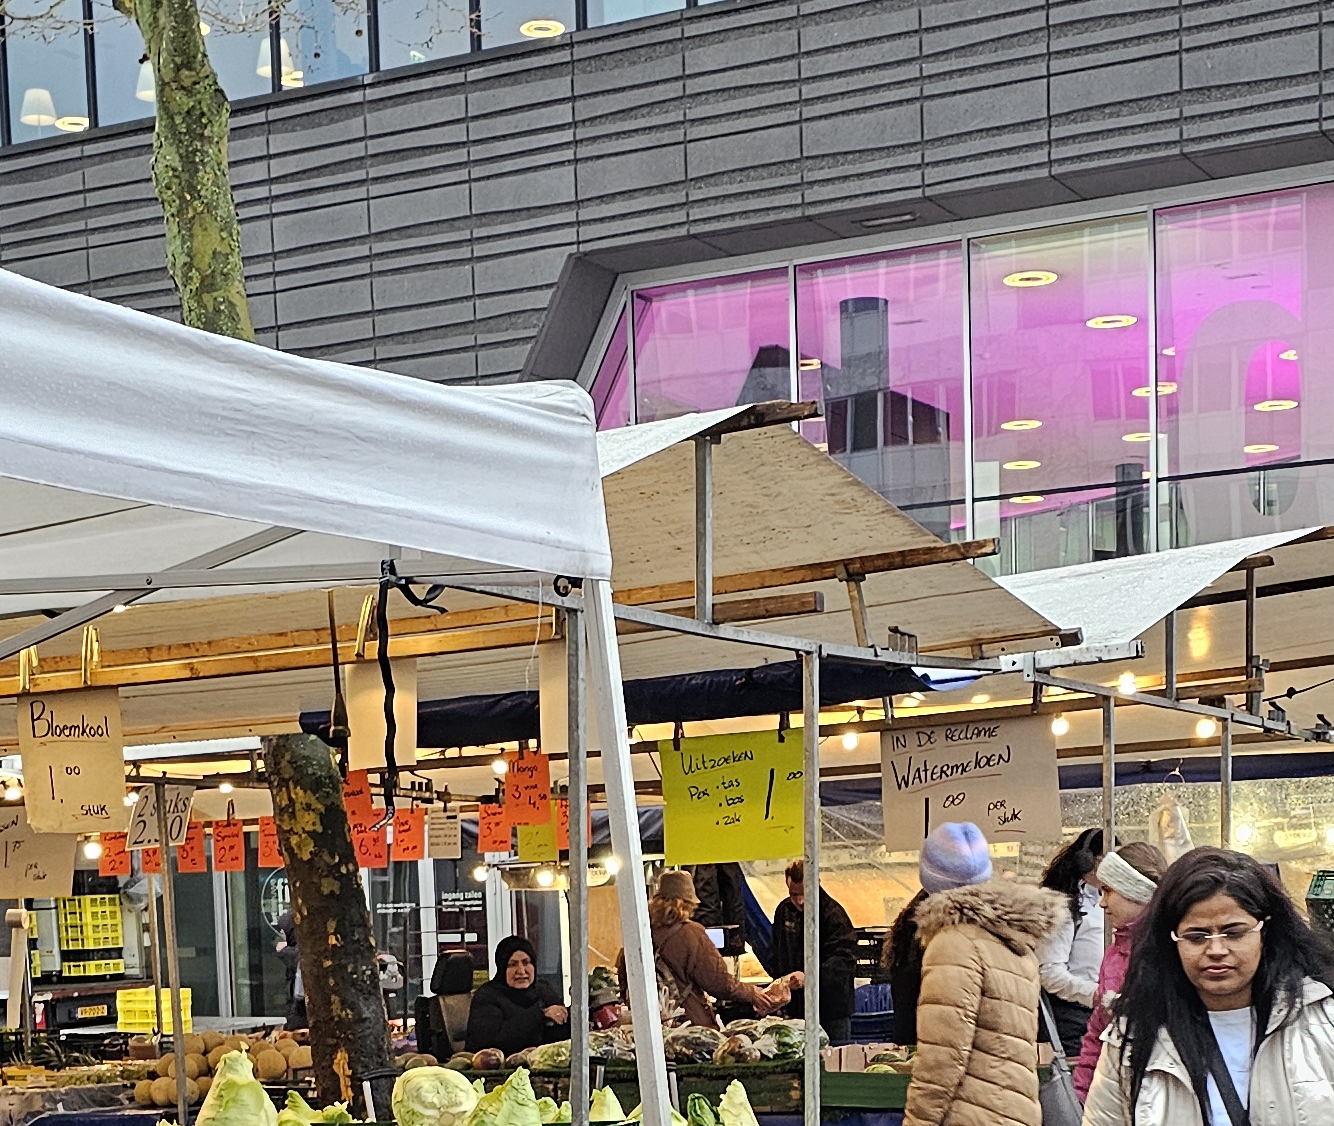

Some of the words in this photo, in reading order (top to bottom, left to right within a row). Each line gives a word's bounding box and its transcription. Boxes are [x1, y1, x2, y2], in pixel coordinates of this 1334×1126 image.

[30, 700, 111, 739] Bloemkool
[891, 734, 907, 753] IN
[917, 730, 938, 748] DE
[945, 724, 1001, 743] RECLAME
[508, 760, 538, 778] Mango
[137, 795, 149, 818] 2
[133, 814, 183, 845] 2.0
